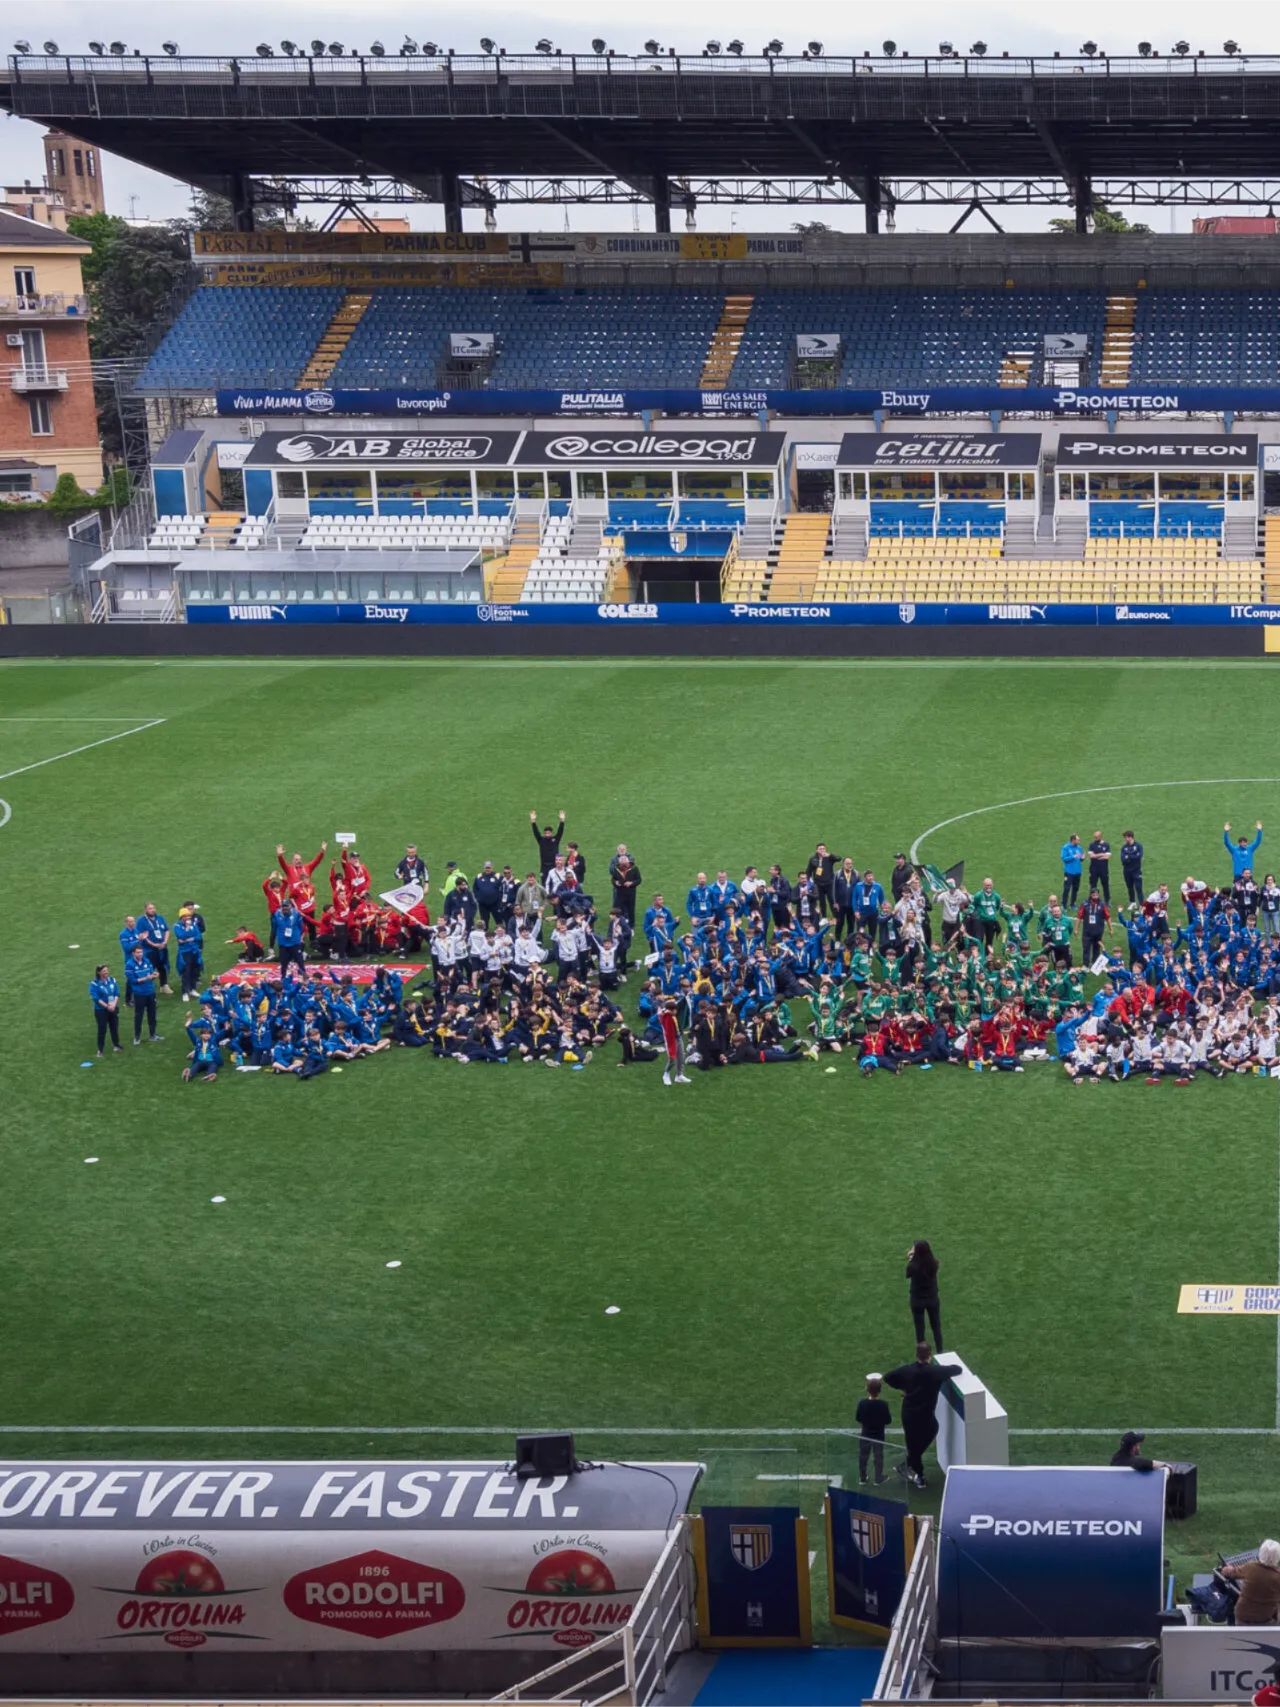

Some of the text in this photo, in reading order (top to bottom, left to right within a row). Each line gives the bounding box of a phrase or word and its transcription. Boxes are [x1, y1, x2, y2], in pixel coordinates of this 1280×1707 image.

[384, 236, 486, 251] PARMA CLUB
[607, 239, 680, 253] COORDINAMENTO
[747, 240, 803, 253] PARMA CLUBS
[264, 395, 302, 409] MAMMA
[304, 396, 335, 407] Beretta
[561, 394, 624, 403] PULITALIA
[723, 392, 767, 401] GAS SALES
[881, 391, 930, 410] Ebury
[1054, 391, 1178, 408] PROMETEON
[724, 401, 767, 409] ENERGIA
[327, 439, 391, 457] AB
[401, 438, 471, 449] Global
[590, 437, 757, 457] callegari
[875, 441, 1007, 457] Cetilar
[1064, 441, 1247, 455] PROMETEON
[397, 448, 477, 458] Service
[715, 452, 752, 460] 1930
[873, 457, 1000, 465] per traumi articolari
[228, 605, 272, 620] PUMA
[365, 605, 408, 621] Ebury
[598, 604, 658, 618] COLSER
[730, 604, 830, 617] PROMETEON
[989, 605, 1031, 619] PUMA
[0, 1471, 580, 1518] OREVER. FASTER.
[961, 1514, 1142, 1537] PROMETEON
[176, 1535, 185, 1545] in
[186, 1533, 218, 1555] Cucina
[566, 1536, 576, 1545] in
[576, 1533, 609, 1556] Cucina
[359, 1566, 391, 1577] 1896
[305, 1581, 444, 1605] RODOLFI
[4, 1610, 41, 1618] PARMA
[117, 1599, 248, 1629] ORTOLINA
[320, 1610, 432, 1619] POMODORO A PARMA
[507, 1600, 632, 1629] ORTOLINA
